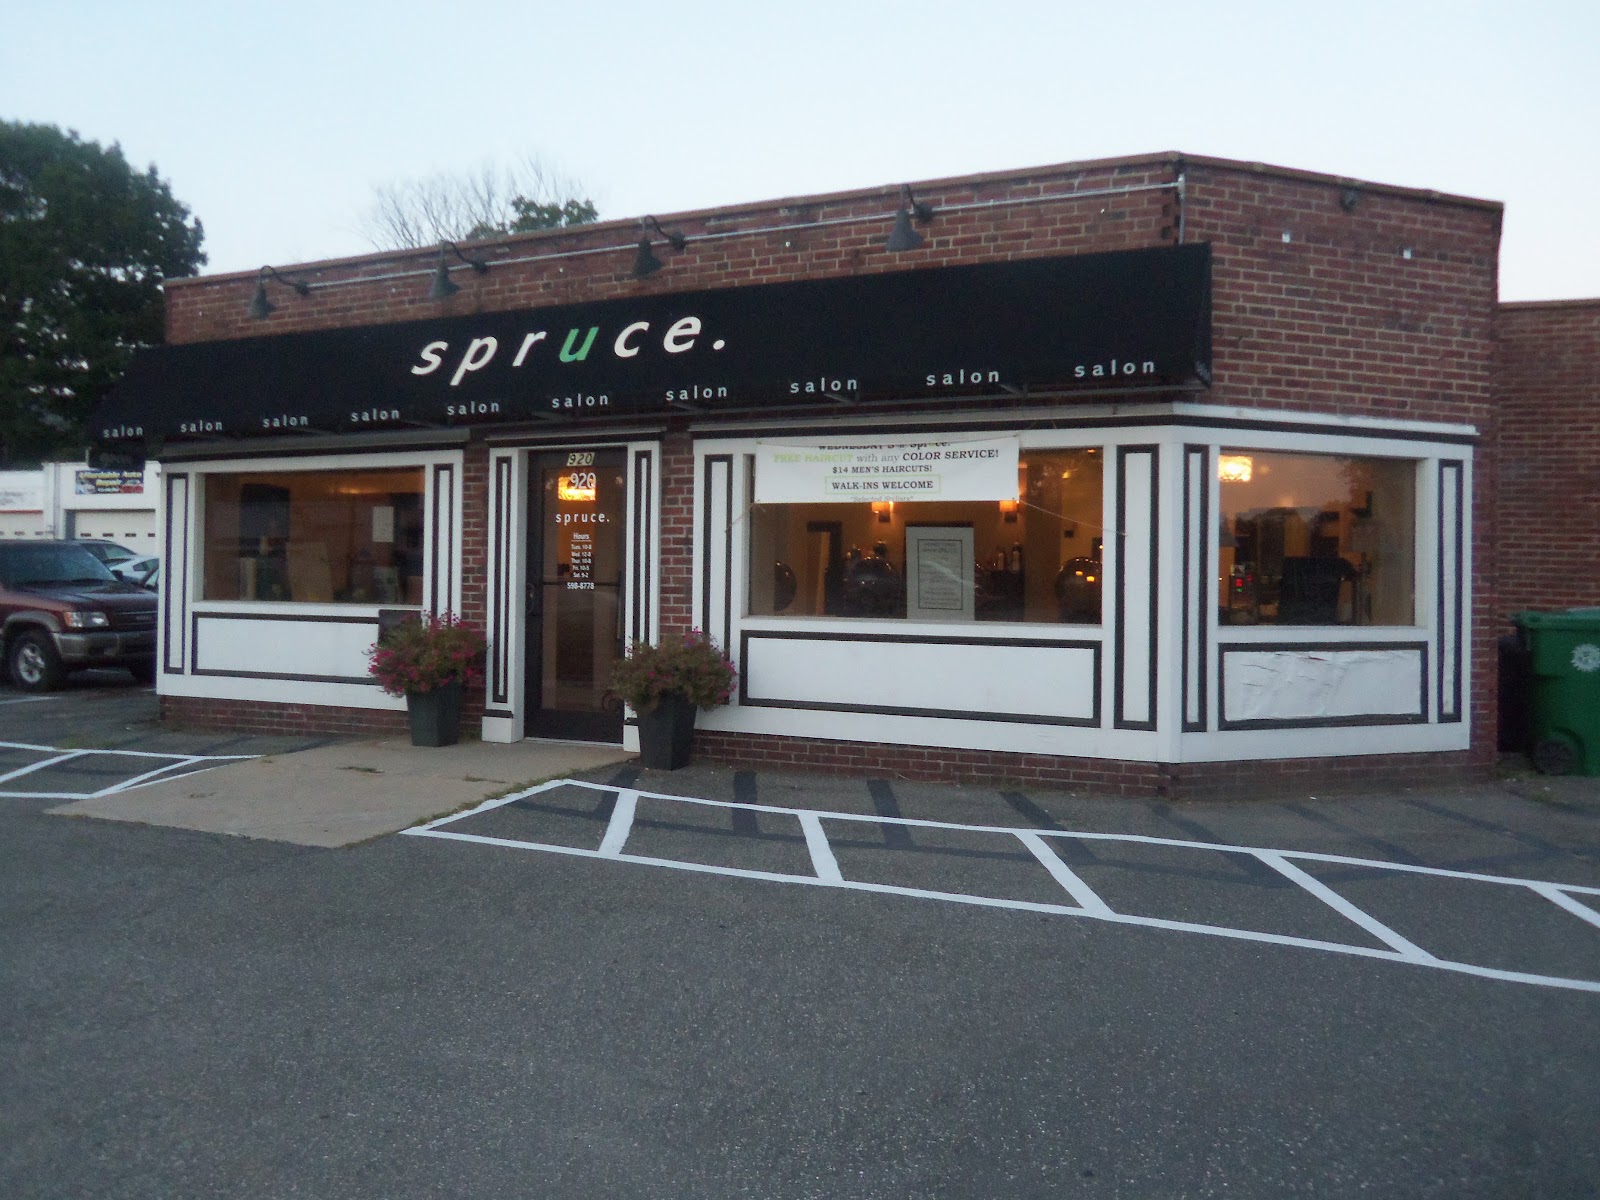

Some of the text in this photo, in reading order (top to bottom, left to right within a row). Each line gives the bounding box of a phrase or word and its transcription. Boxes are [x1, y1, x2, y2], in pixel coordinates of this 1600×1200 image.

[410, 315, 727, 388] spruce.
[1074, 359, 1156, 378] salon
[926, 368, 1001, 386] salon
[790, 376, 858, 394] salon
[665, 384, 728, 402] salon
[446, 400, 500, 416] salon
[551, 393, 609, 409] salon
[262, 414, 309, 428] salon
[350, 408, 400, 423] salon
[102, 425, 144, 439] salon
[180, 419, 223, 433] salon
[569, 453, 593, 465] 920
[774, 449, 999, 463] FREE HAIRCUT with any COLOR SERVICE!
[832, 464, 933, 474] $14 MEN'S HAIRCUTS!
[570, 472, 597, 490] 920
[832, 480, 934, 490] WALK-INS WELCOME
[555, 513, 610, 526] spruce.
[573, 532, 590, 540] Hours
